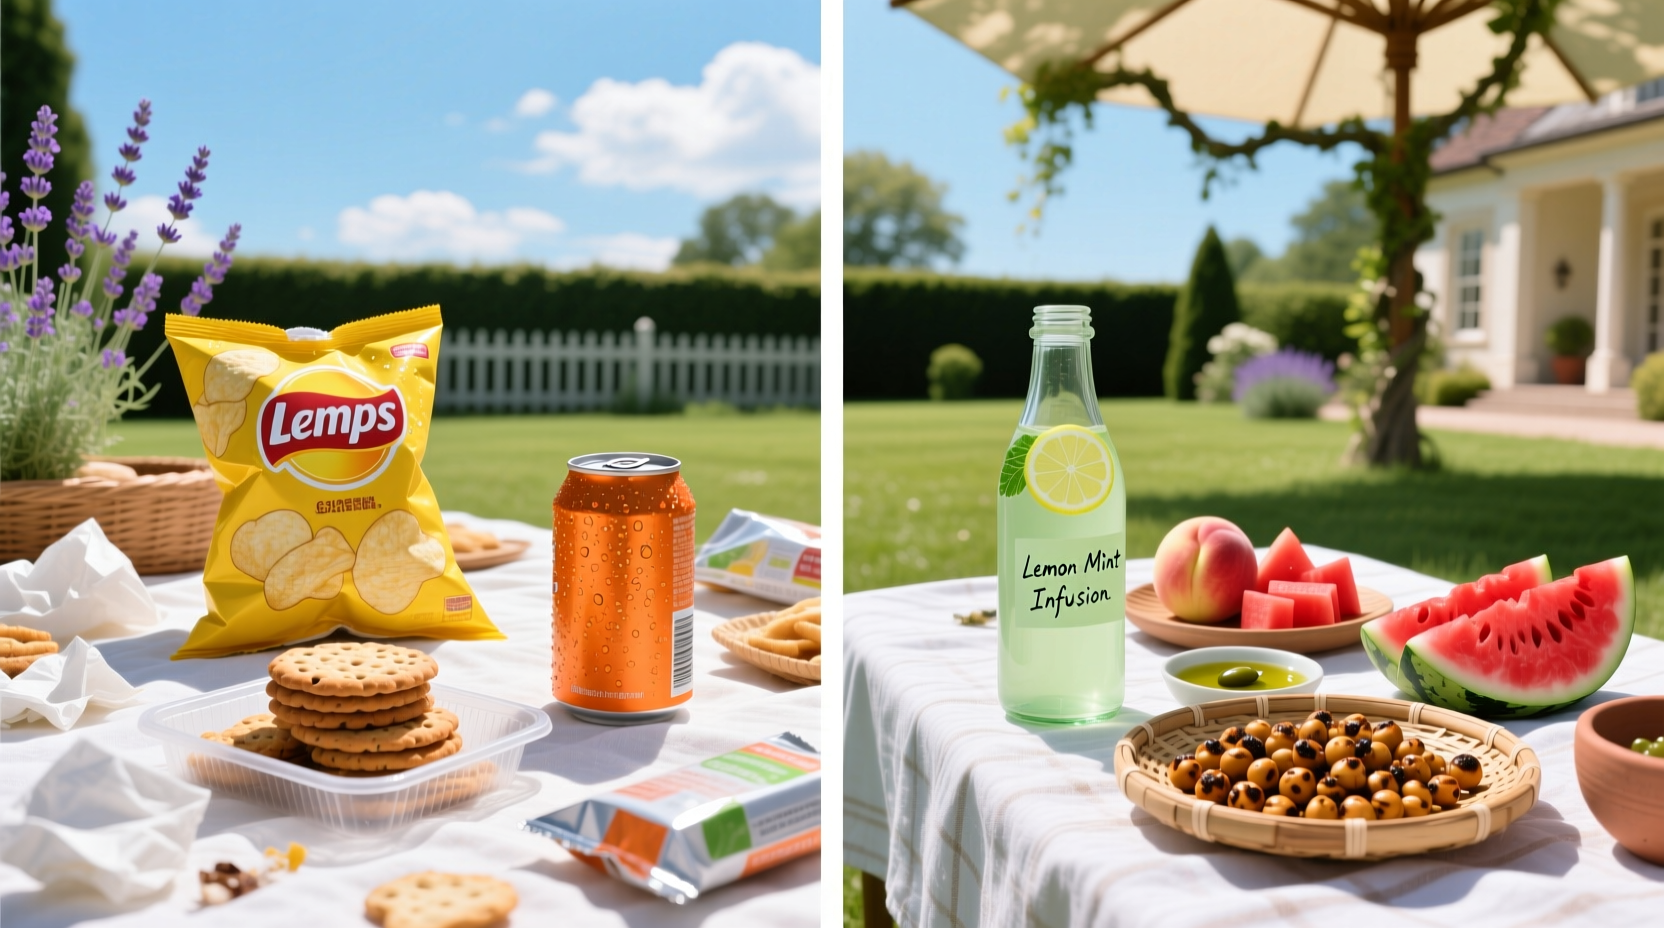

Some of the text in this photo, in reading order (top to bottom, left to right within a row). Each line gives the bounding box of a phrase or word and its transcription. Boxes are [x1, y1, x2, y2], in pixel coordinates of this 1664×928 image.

[269, 401, 396, 445] Lemps
[1022, 549, 1121, 579] Lemon Mint
[1030, 585, 1111, 618] Infusion
